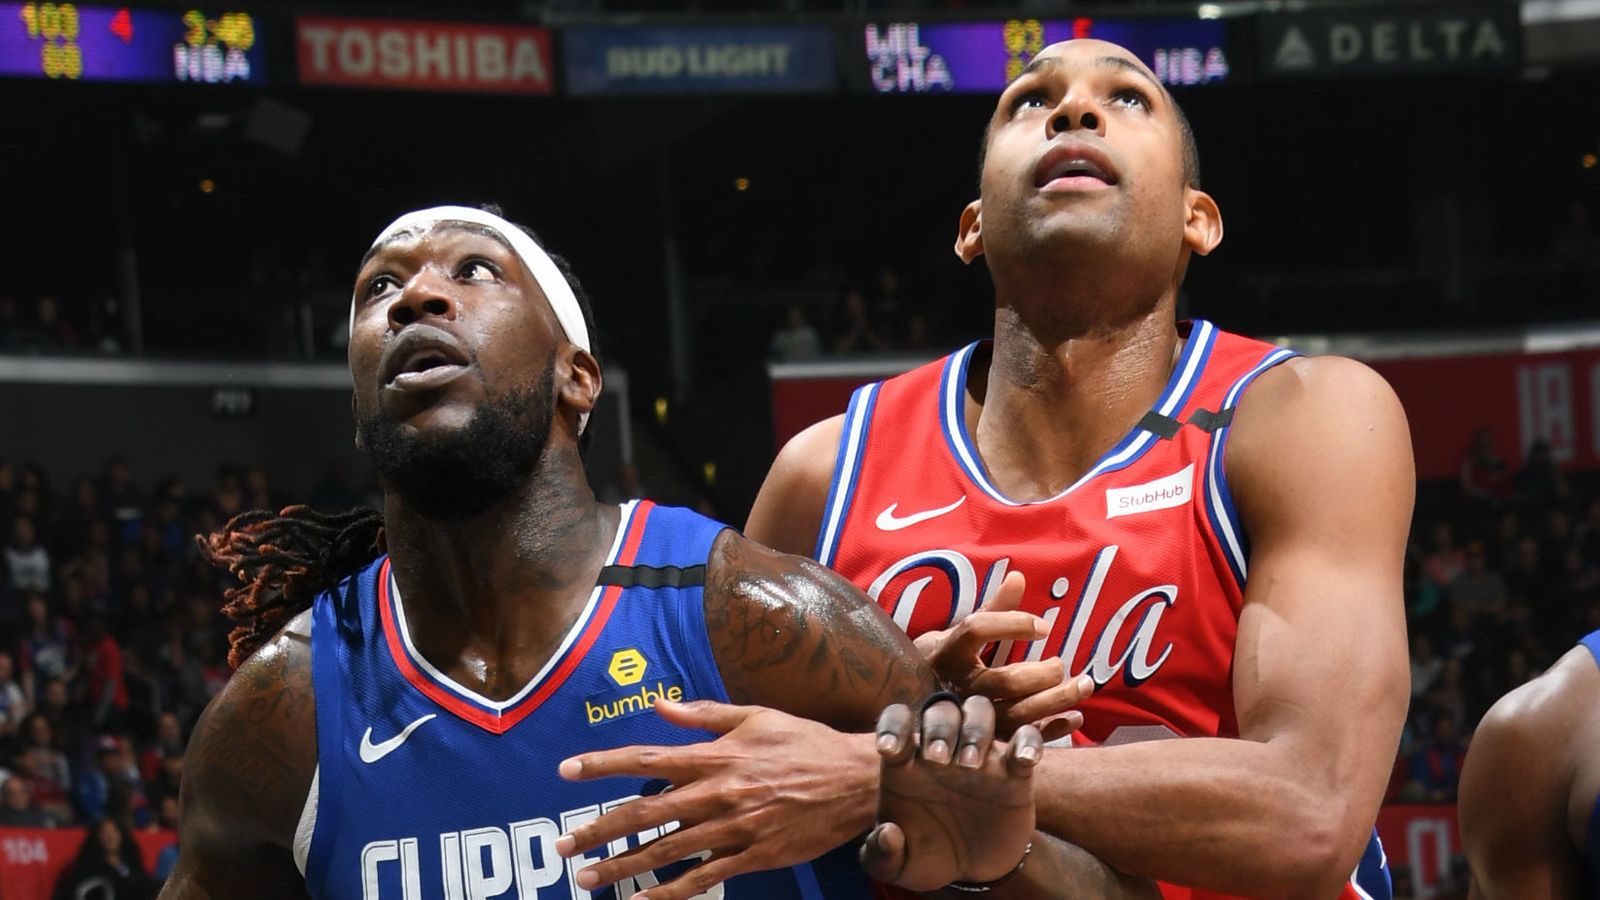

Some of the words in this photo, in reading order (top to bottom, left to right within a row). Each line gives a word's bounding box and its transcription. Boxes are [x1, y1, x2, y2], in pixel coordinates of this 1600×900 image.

[302, 25, 547, 83] TOSHIBA
[607, 46, 683, 78] BUD
[687, 42, 792, 77] LIGHT
[1330, 21, 1505, 64] DELTA
[174, 44, 250, 83] NBA
[872, 54, 954, 91] CHA
[1119, 485, 1184, 508] StubHub
[586, 682, 682, 724] bumble
